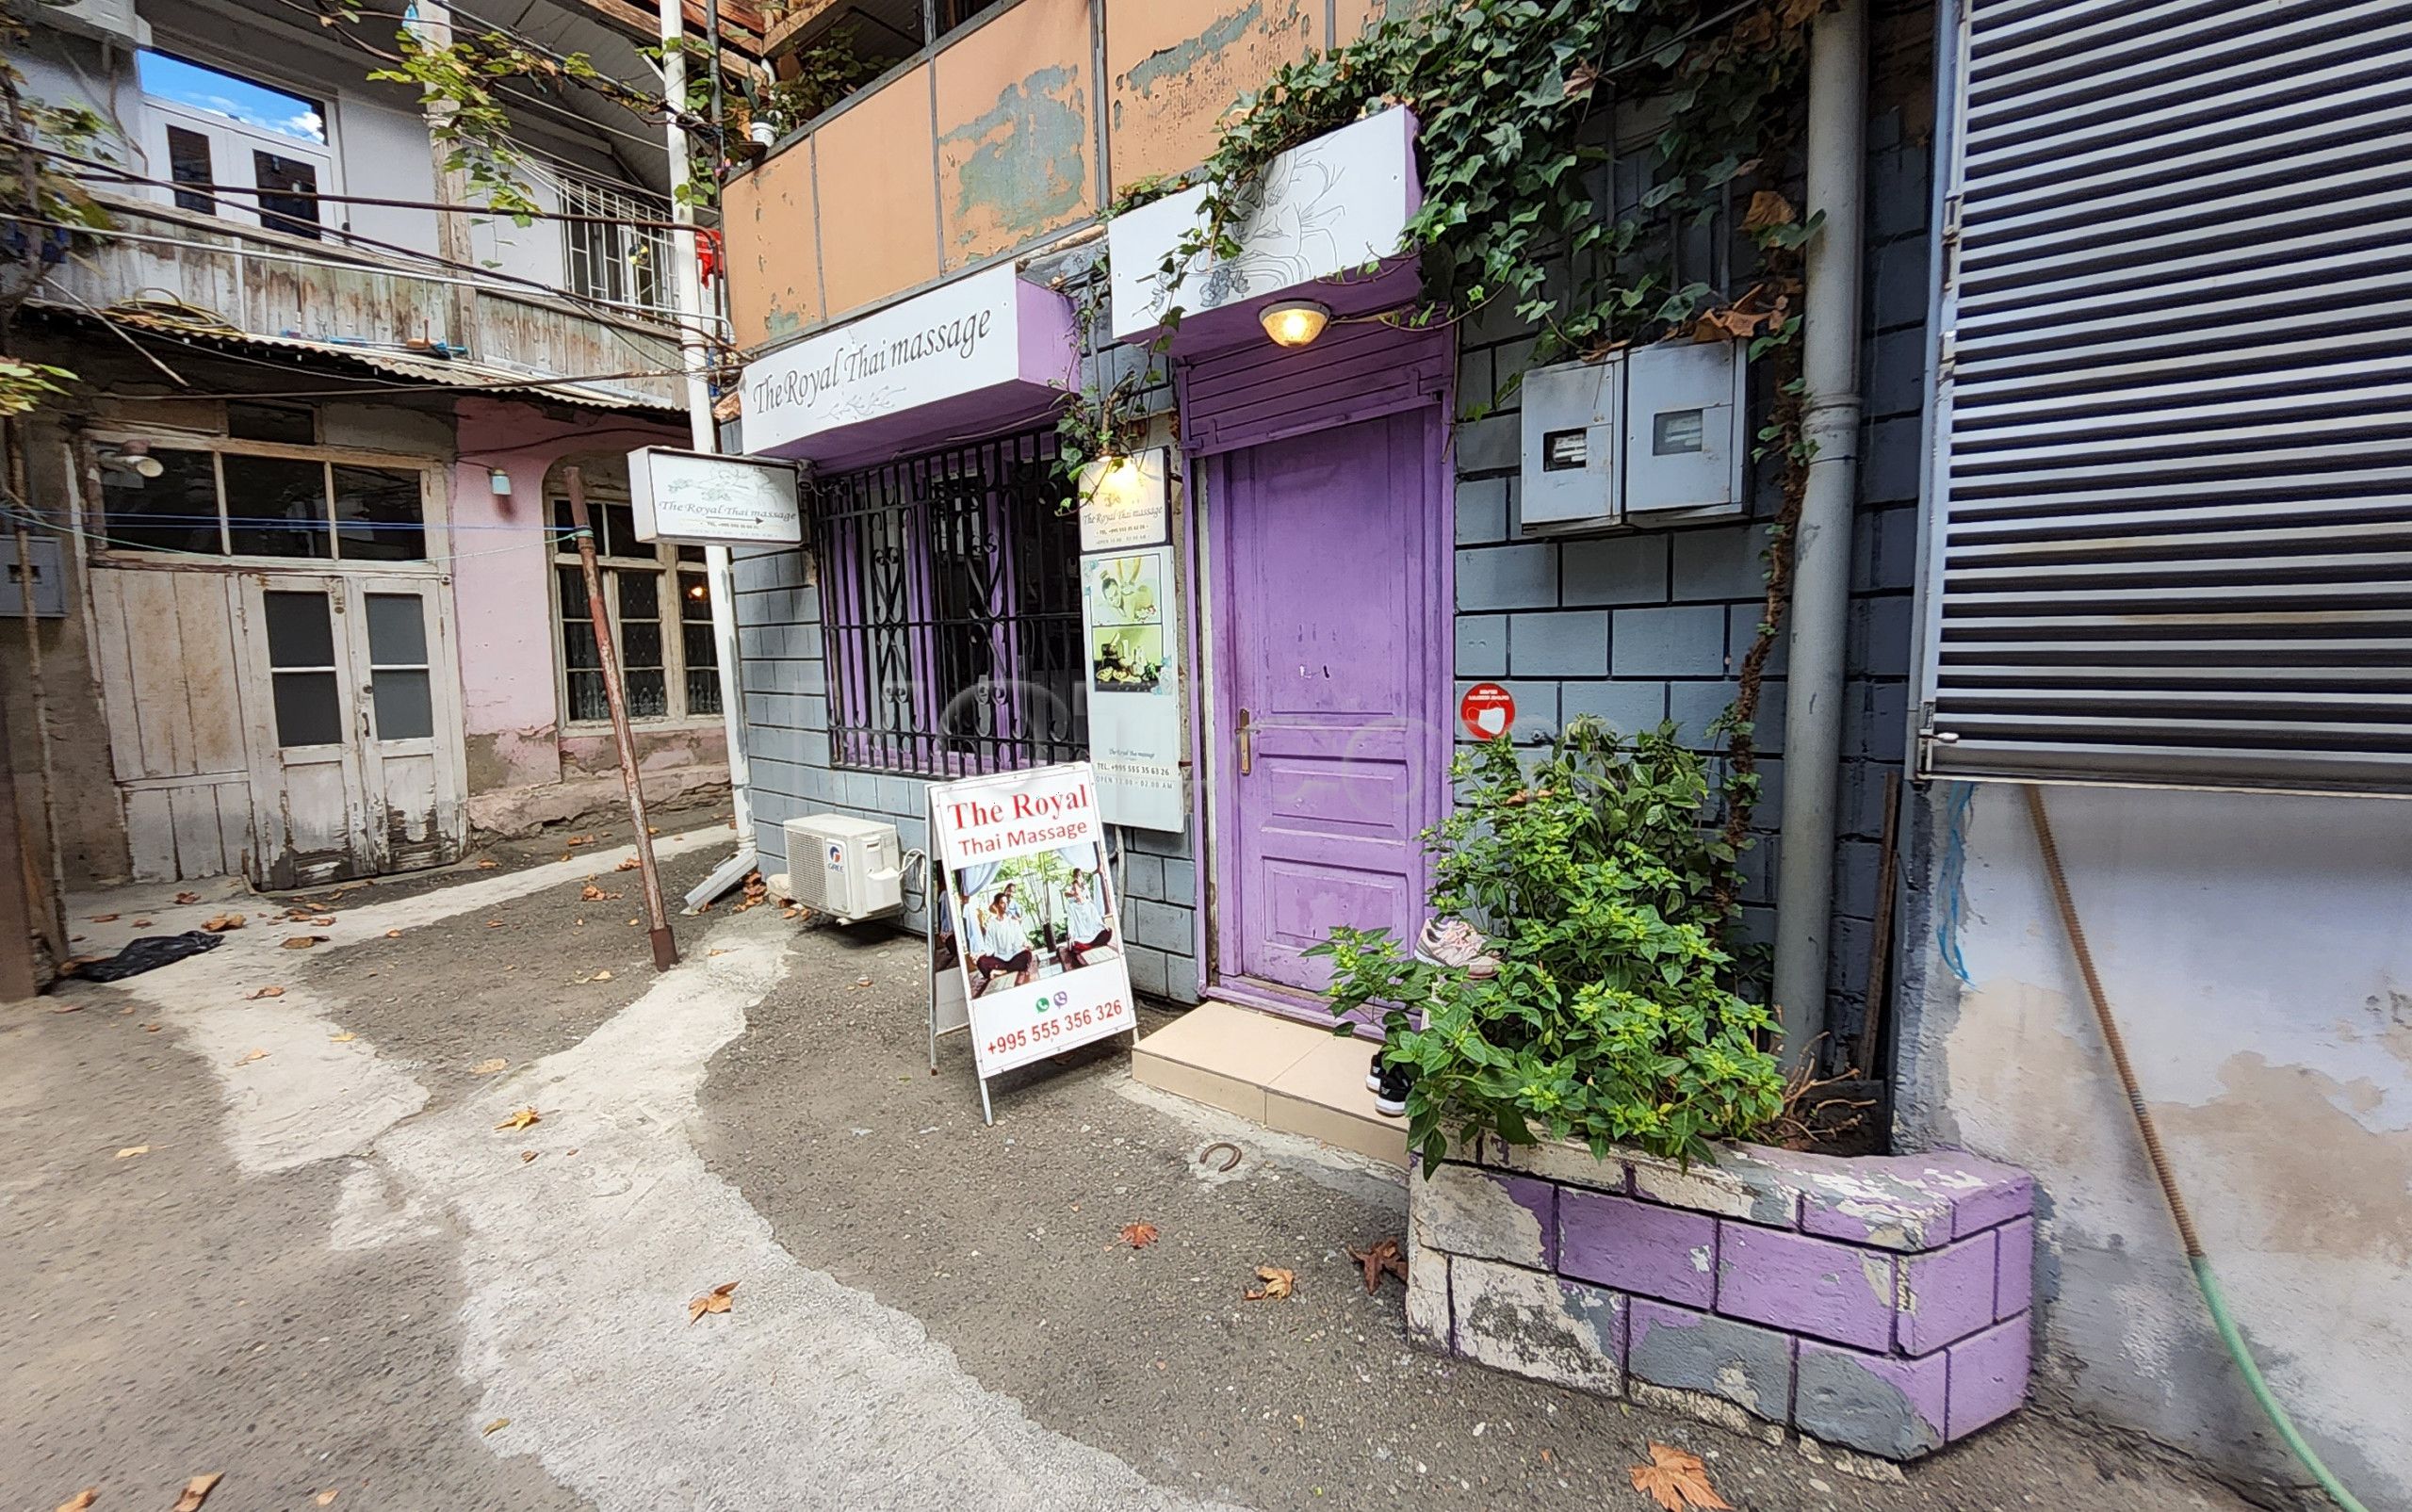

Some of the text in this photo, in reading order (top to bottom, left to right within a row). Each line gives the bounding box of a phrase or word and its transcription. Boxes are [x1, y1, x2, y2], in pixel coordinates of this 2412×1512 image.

[753, 308, 992, 415] The Royal Thai massage
[659, 500, 797, 522] The Royal Thai massage
[1097, 762, 1110, 771] TEL.
[1128, 765, 1139, 773] 555
[1141, 766, 1149, 774] 35
[1150, 767, 1159, 775] 63
[1161, 768, 1170, 776] 26
[947, 784, 1089, 832] The Royal
[958, 820, 1088, 858] Thai Massage
[987, 999, 1123, 1056] +995 555 356 326
